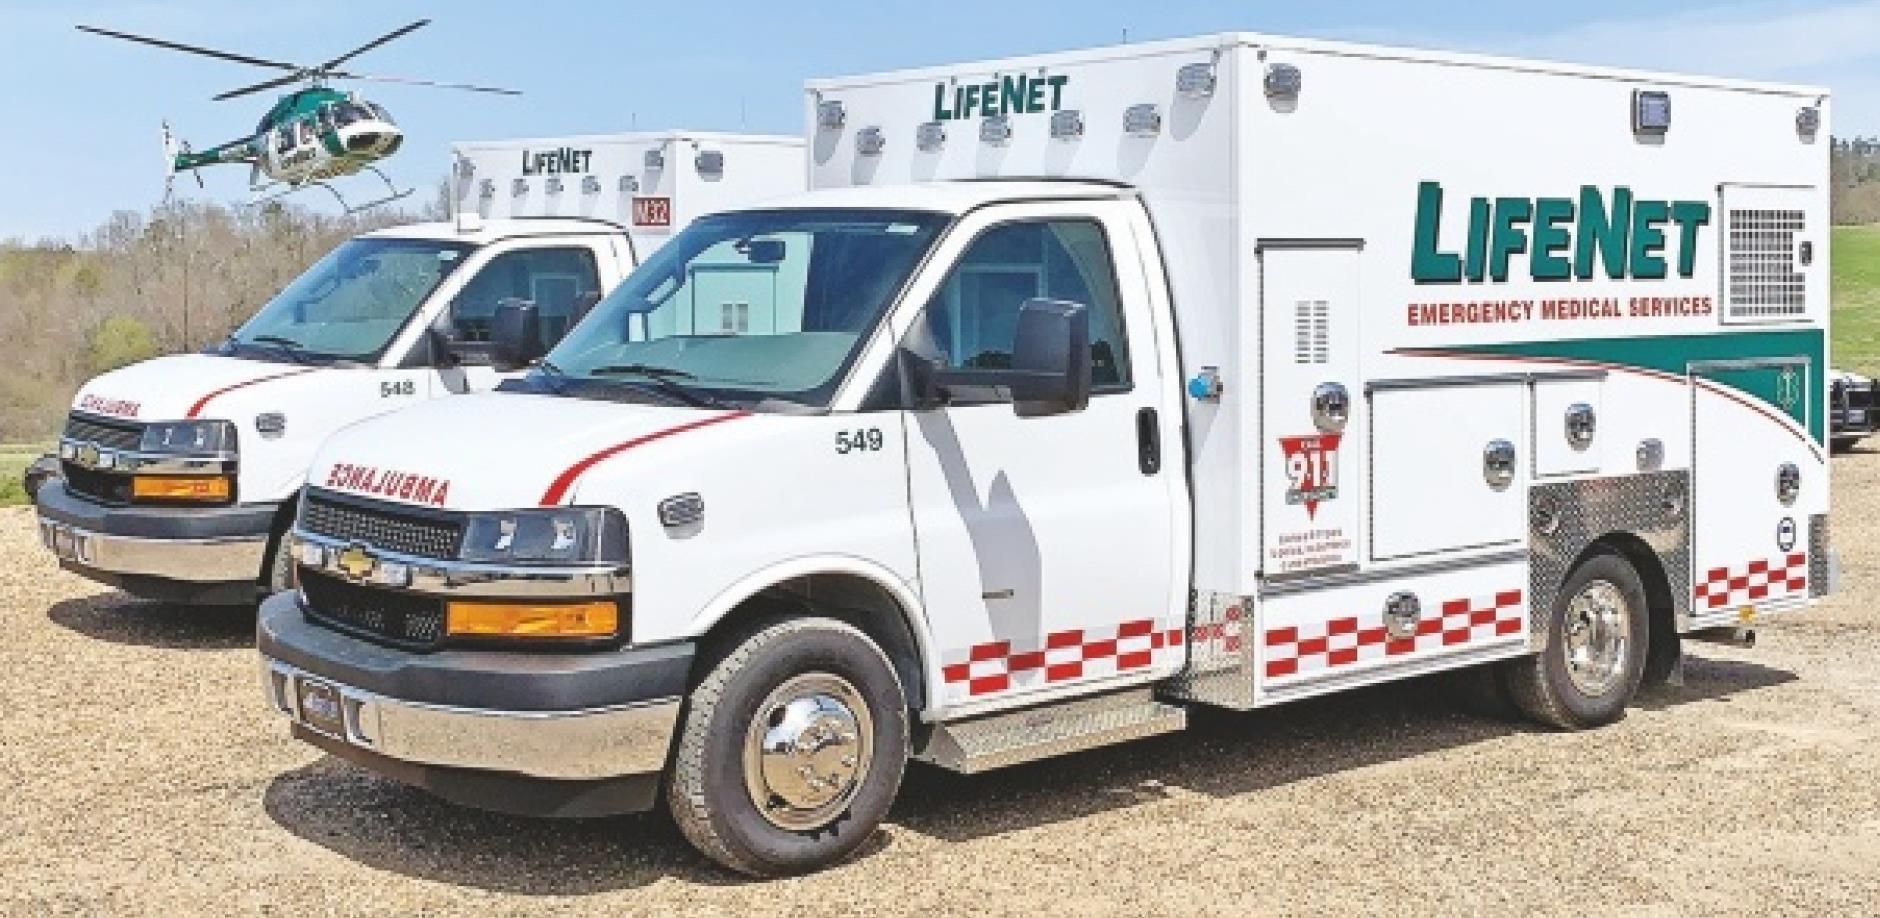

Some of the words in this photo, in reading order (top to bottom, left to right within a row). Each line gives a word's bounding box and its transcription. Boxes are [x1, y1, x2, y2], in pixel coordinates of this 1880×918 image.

[1411, 181, 1712, 285] LIFENET
[1407, 300, 1534, 326] EMERGENCY
[1541, 296, 1621, 320] MEDICAL
[1629, 296, 1712, 317] SERVICES
[380, 380, 416, 398] 548
[835, 428, 882, 454] 549
